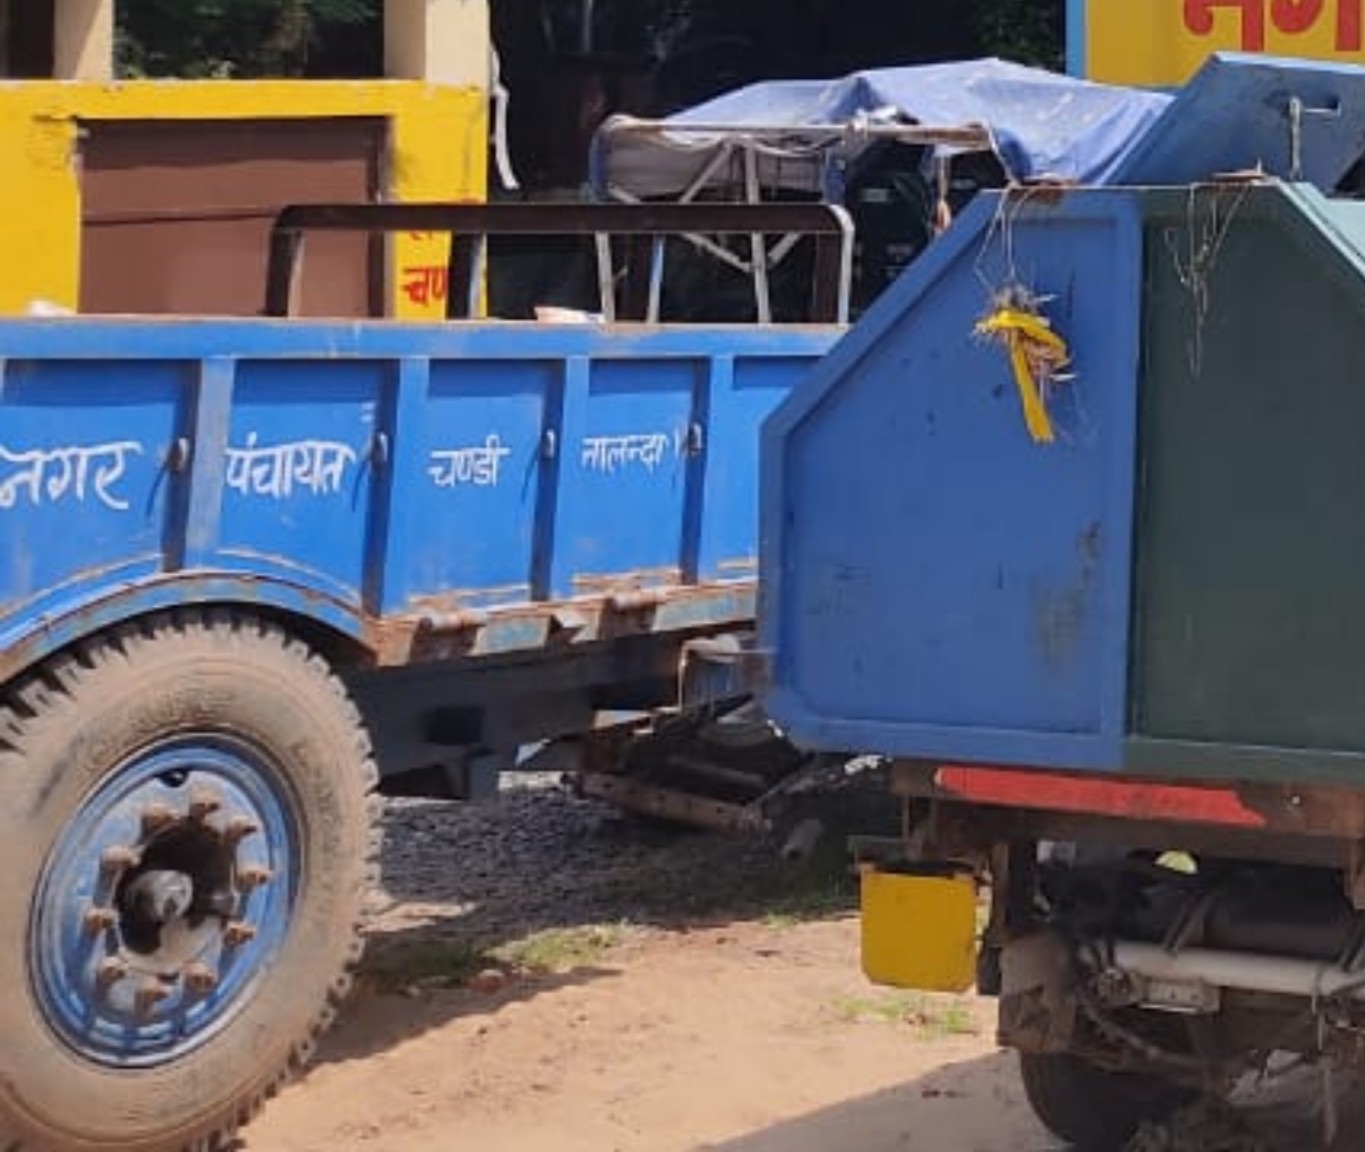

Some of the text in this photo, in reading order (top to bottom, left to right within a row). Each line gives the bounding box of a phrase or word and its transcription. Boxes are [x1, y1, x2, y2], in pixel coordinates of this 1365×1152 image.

[0, 440, 143, 509] नगर
[225, 431, 356, 498] पंचायत
[428, 434, 510, 487] चण्डी
